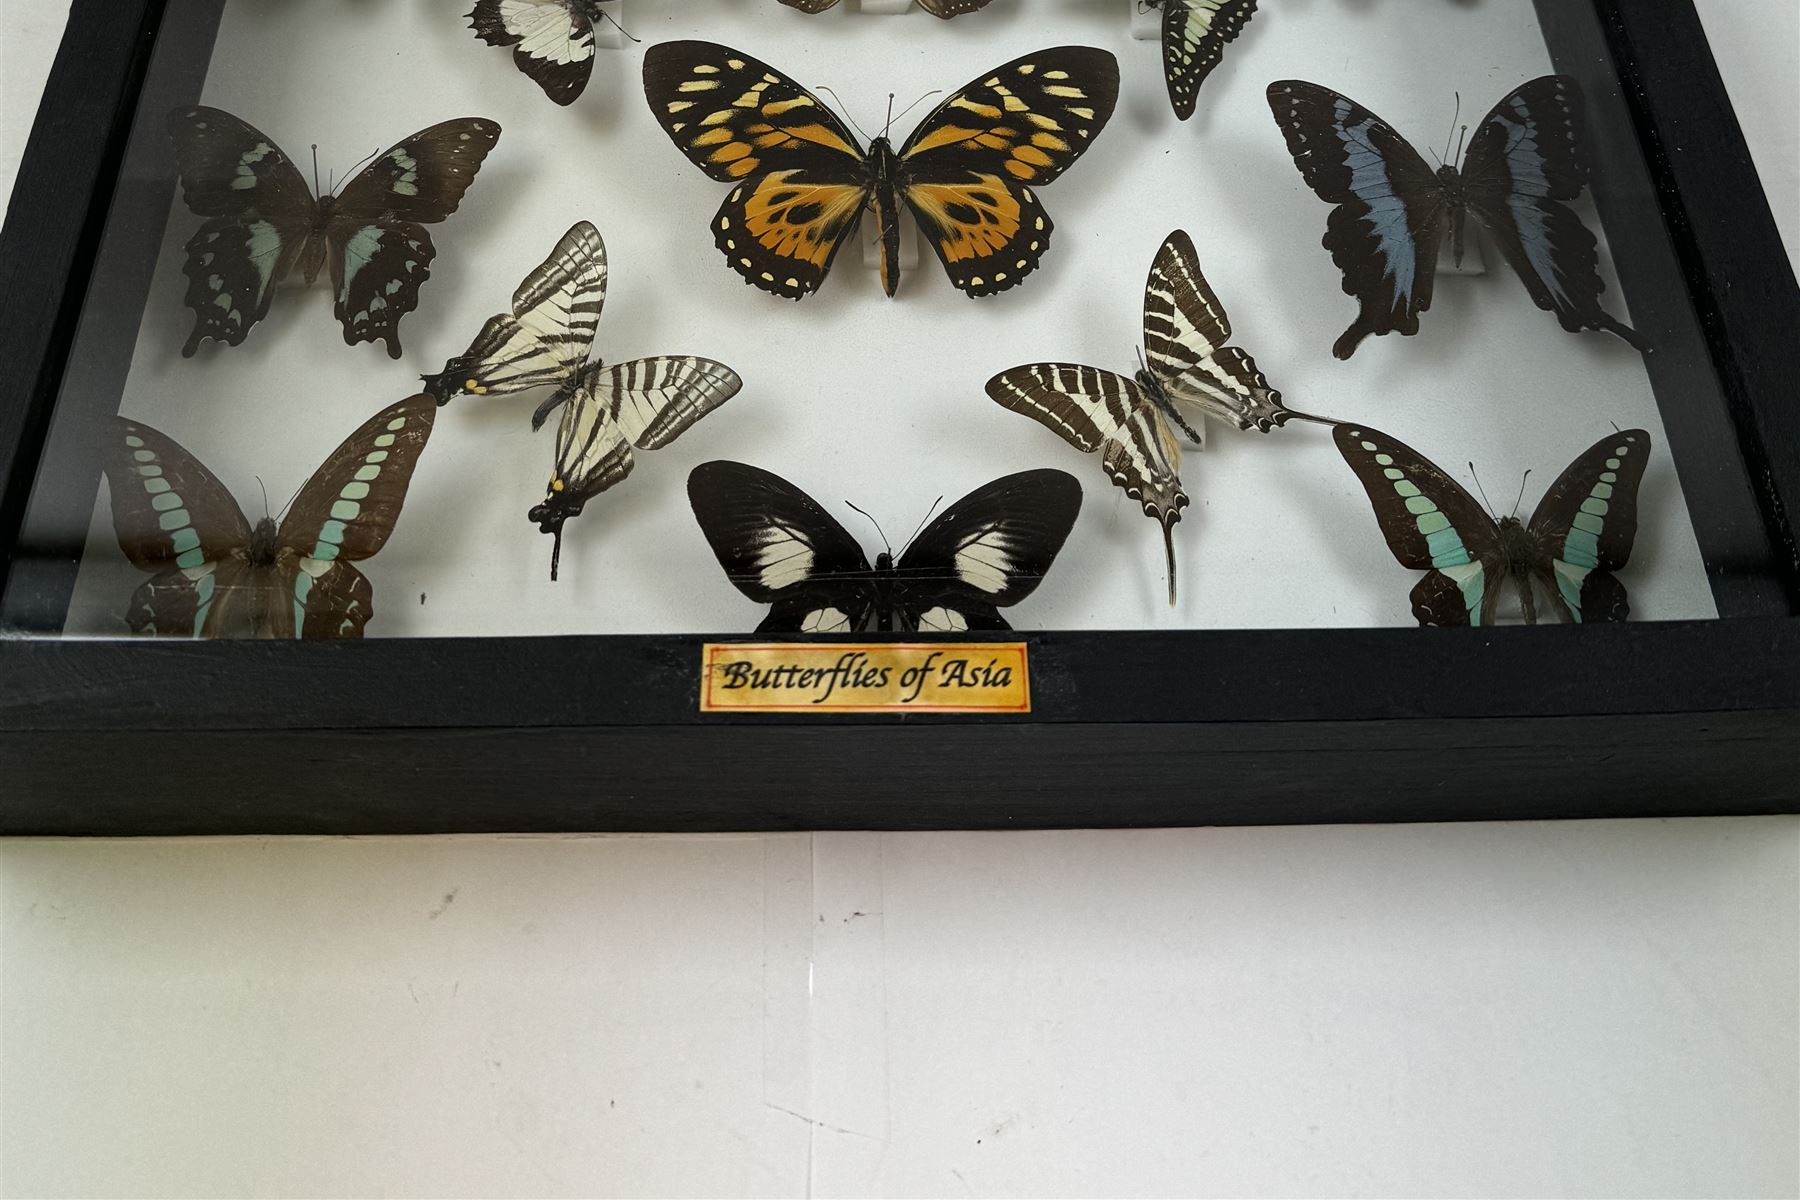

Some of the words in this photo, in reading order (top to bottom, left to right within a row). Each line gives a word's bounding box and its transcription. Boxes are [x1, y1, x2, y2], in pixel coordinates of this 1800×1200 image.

[722, 652, 892, 704] Butterflies
[900, 651, 944, 703] of
[937, 658, 1012, 689] Asia
